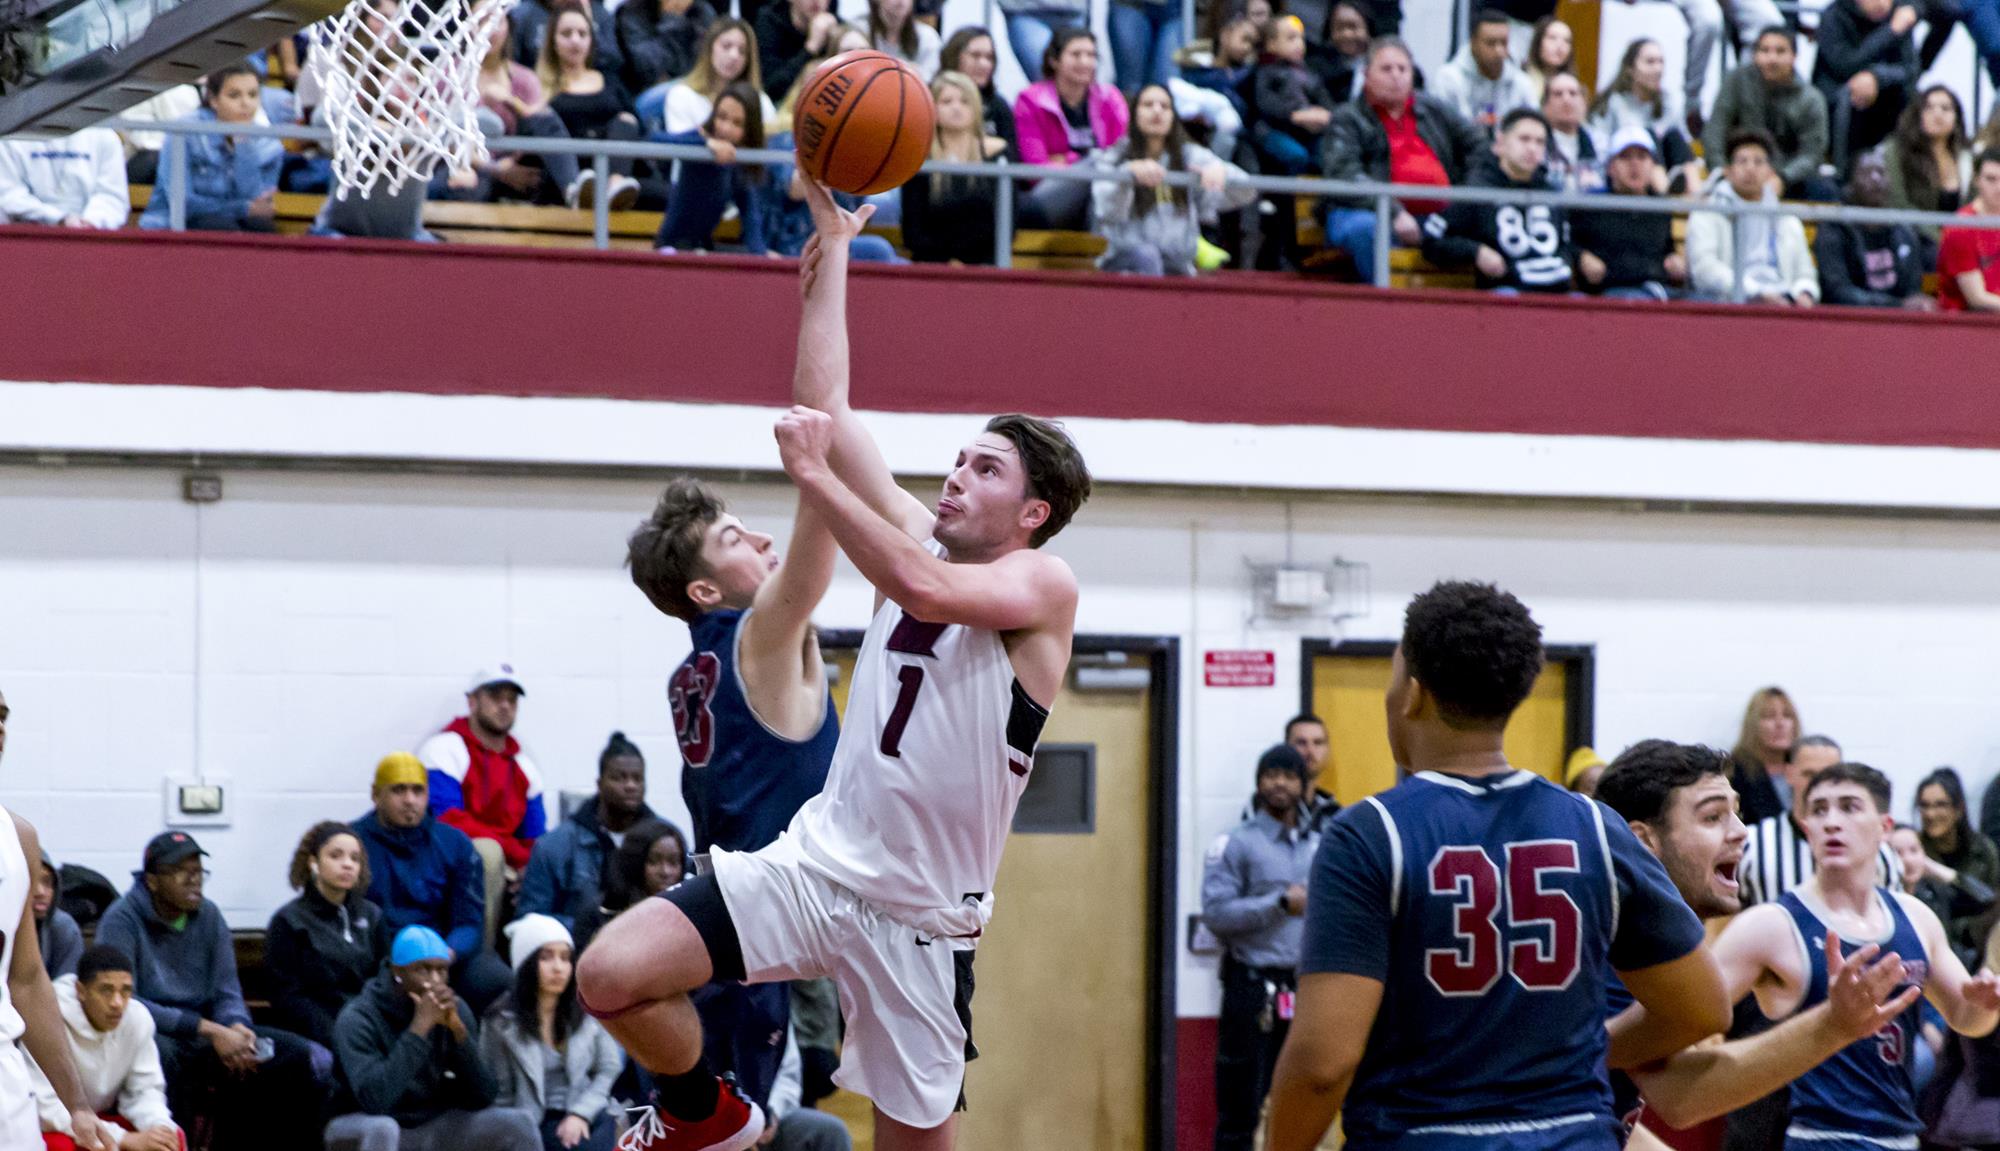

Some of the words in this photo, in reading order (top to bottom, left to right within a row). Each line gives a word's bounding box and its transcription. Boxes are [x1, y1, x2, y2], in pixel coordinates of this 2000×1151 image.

[815, 74, 854, 117] THE
[1496, 205, 1559, 258] 85
[880, 664, 924, 758] 1
[1424, 838, 1582, 997] 35
